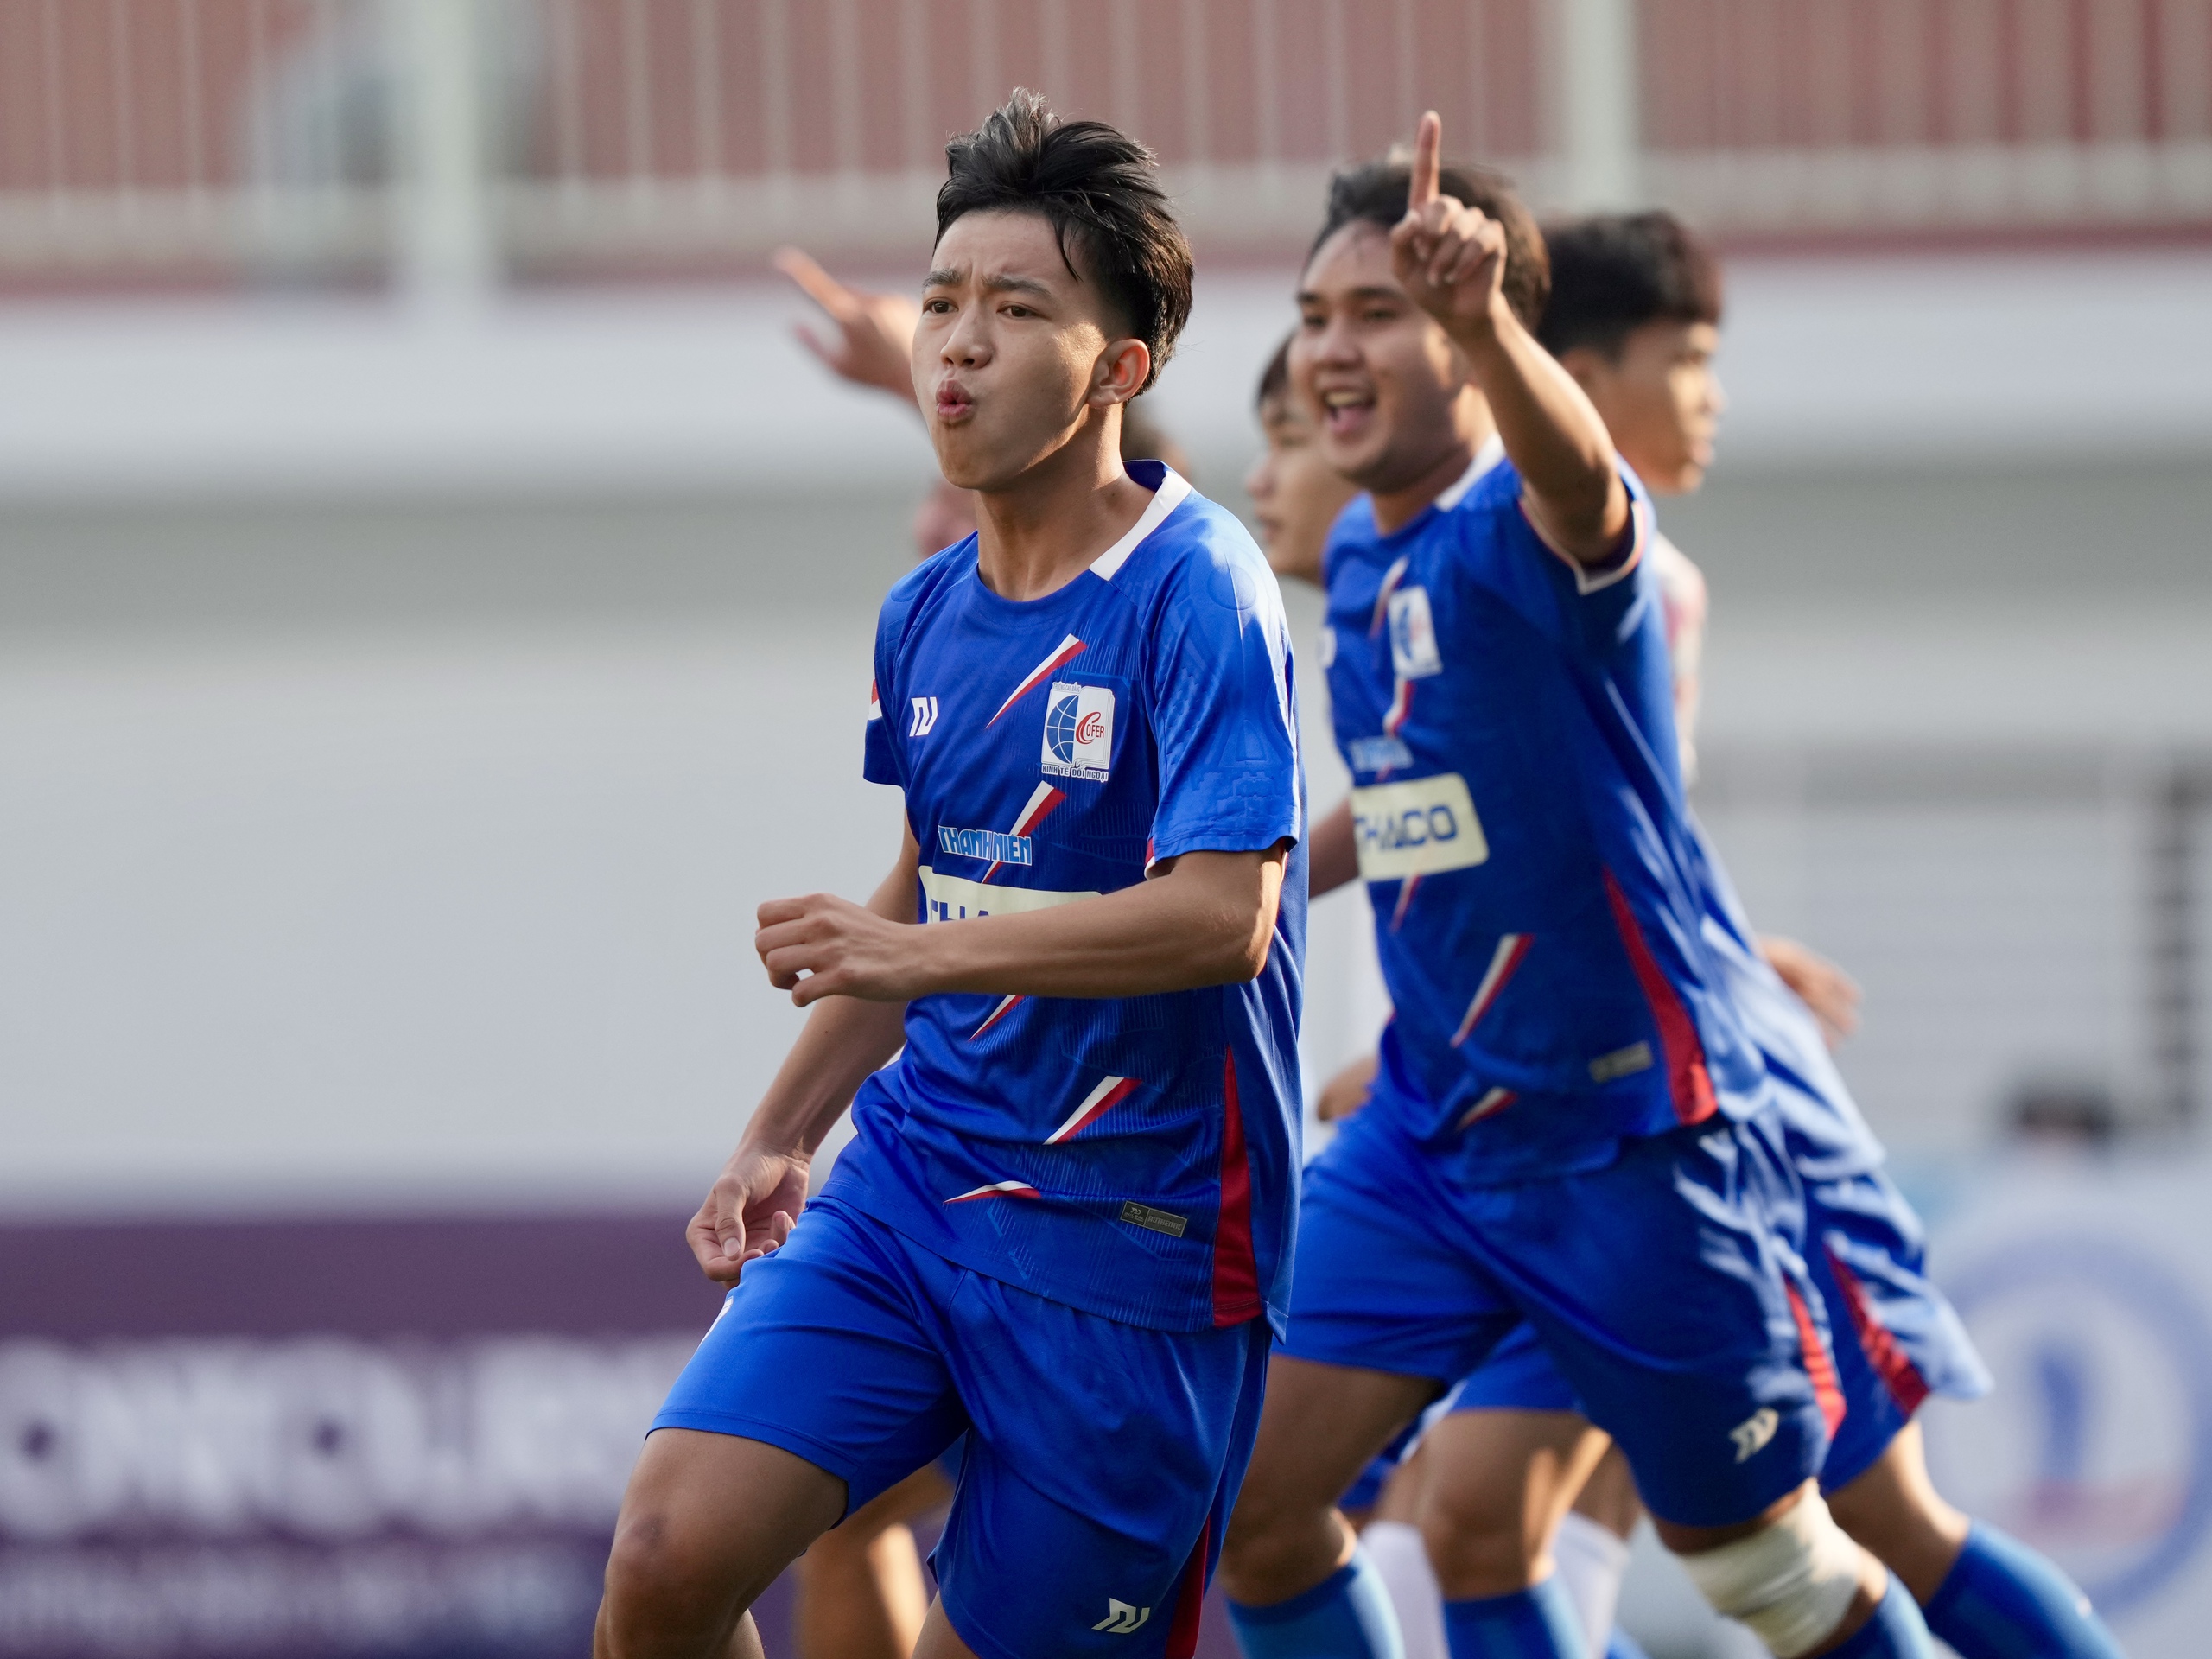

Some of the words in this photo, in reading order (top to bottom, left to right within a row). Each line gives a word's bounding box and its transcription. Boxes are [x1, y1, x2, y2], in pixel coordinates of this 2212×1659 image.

[1076, 711, 1105, 745] COFER
[1042, 765, 1058, 774] KINH
[1086, 770, 1109, 782] NGOẠI
[938, 825, 992, 861] THANH
